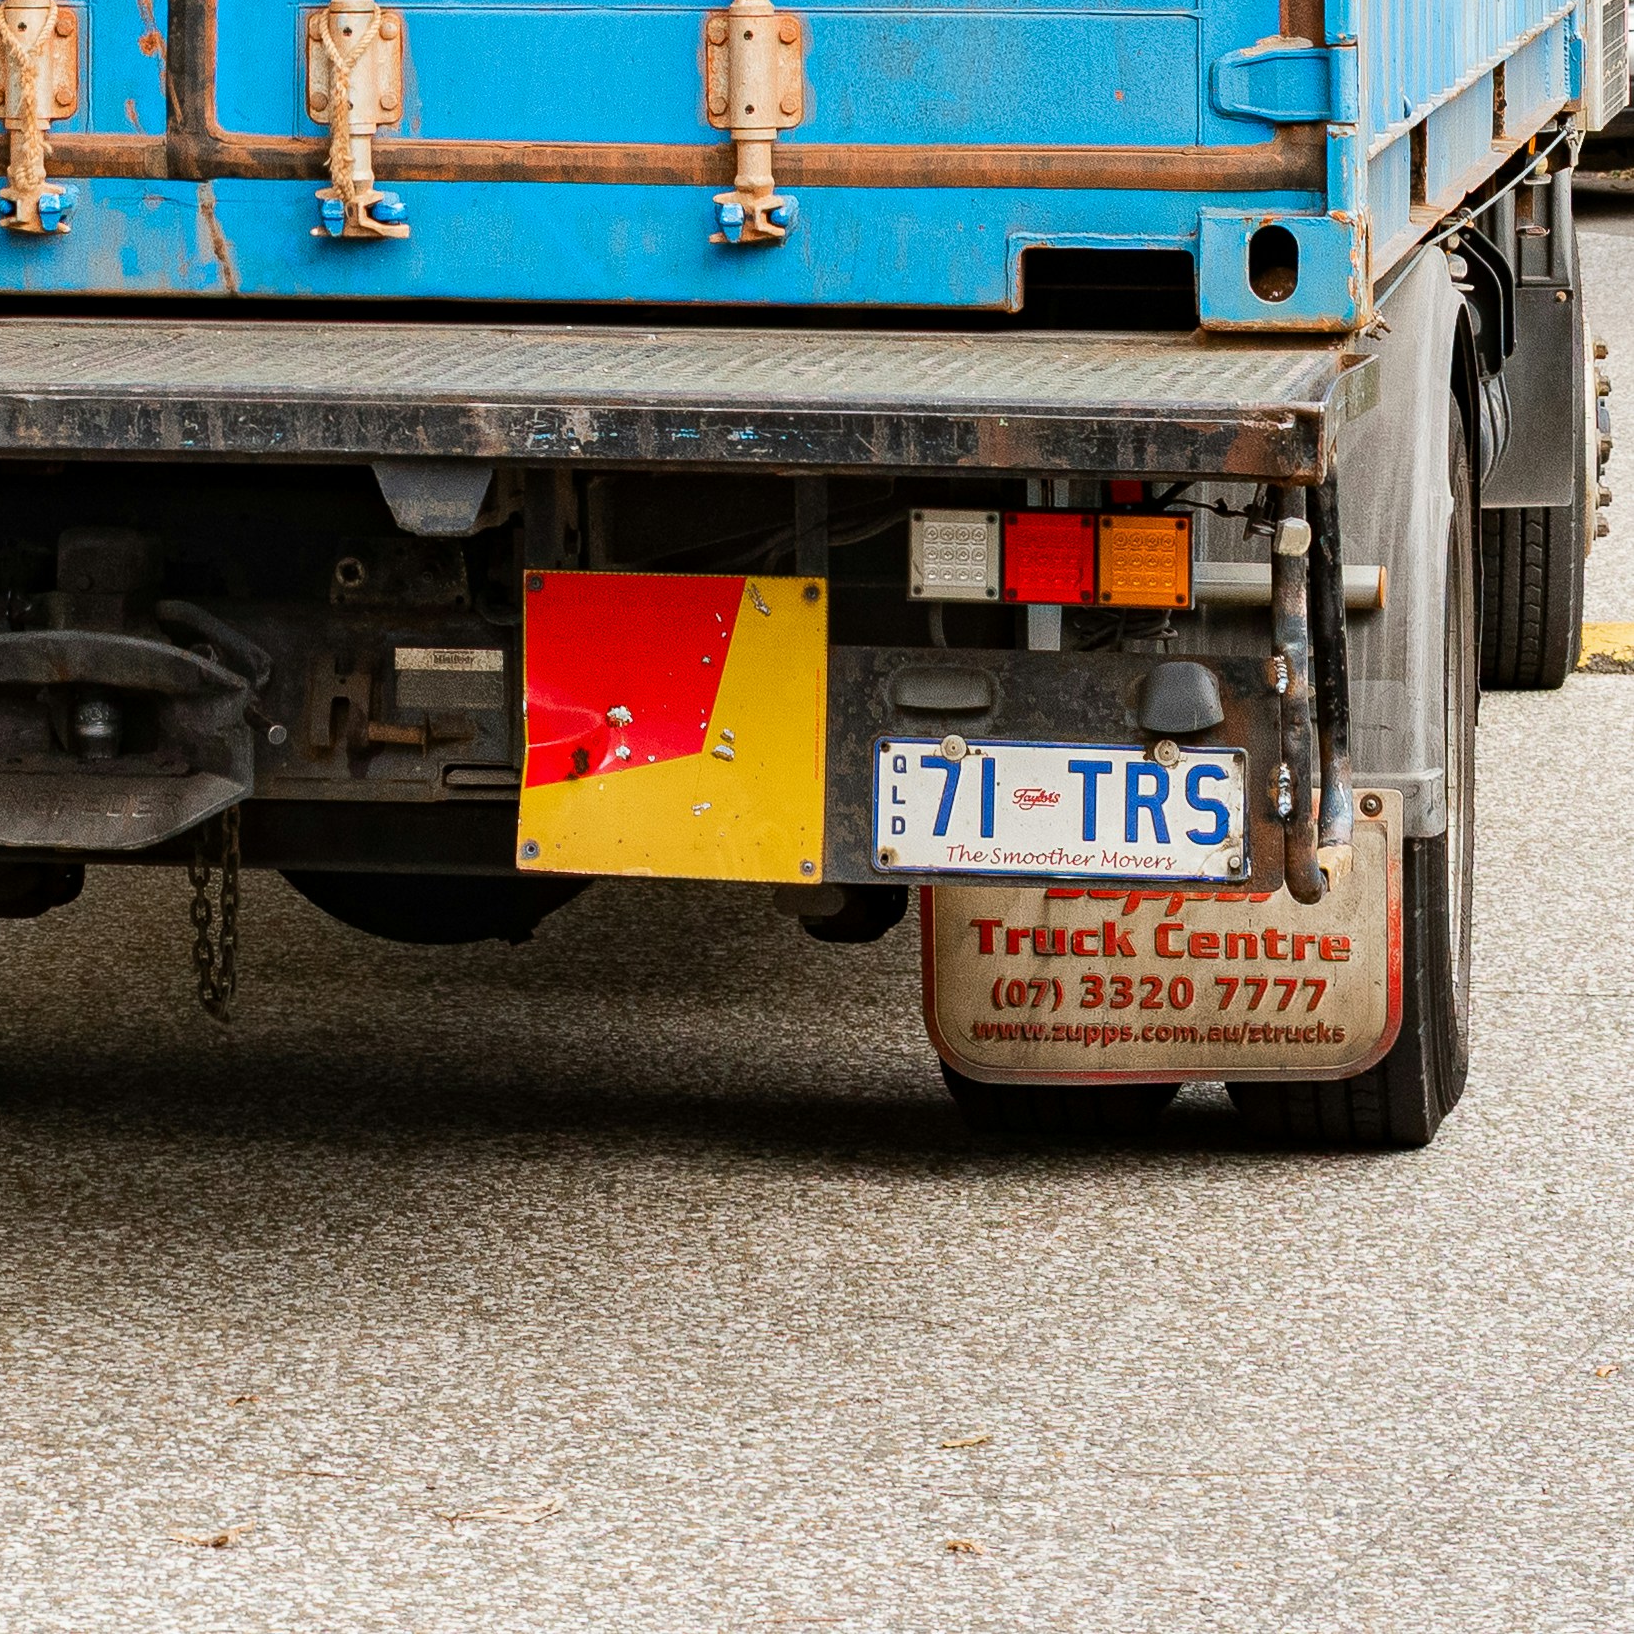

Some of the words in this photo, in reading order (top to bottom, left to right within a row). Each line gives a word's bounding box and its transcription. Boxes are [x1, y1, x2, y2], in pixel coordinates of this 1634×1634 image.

[1068, 759, 1231, 846] TRS
[945, 844, 989, 863] The
[989, 846, 1095, 868] Smoother
[1100, 850, 1178, 871] Movers
[970, 918, 1138, 958] Truck
[1154, 921, 1352, 962] Centre
[992, 977, 1065, 1012] (07)
[1080, 973, 1195, 1010] 3320
[1215, 976, 1329, 1012] 7777
[972, 1019, 1347, 1049] www.zupps.com.au/ztrucks
